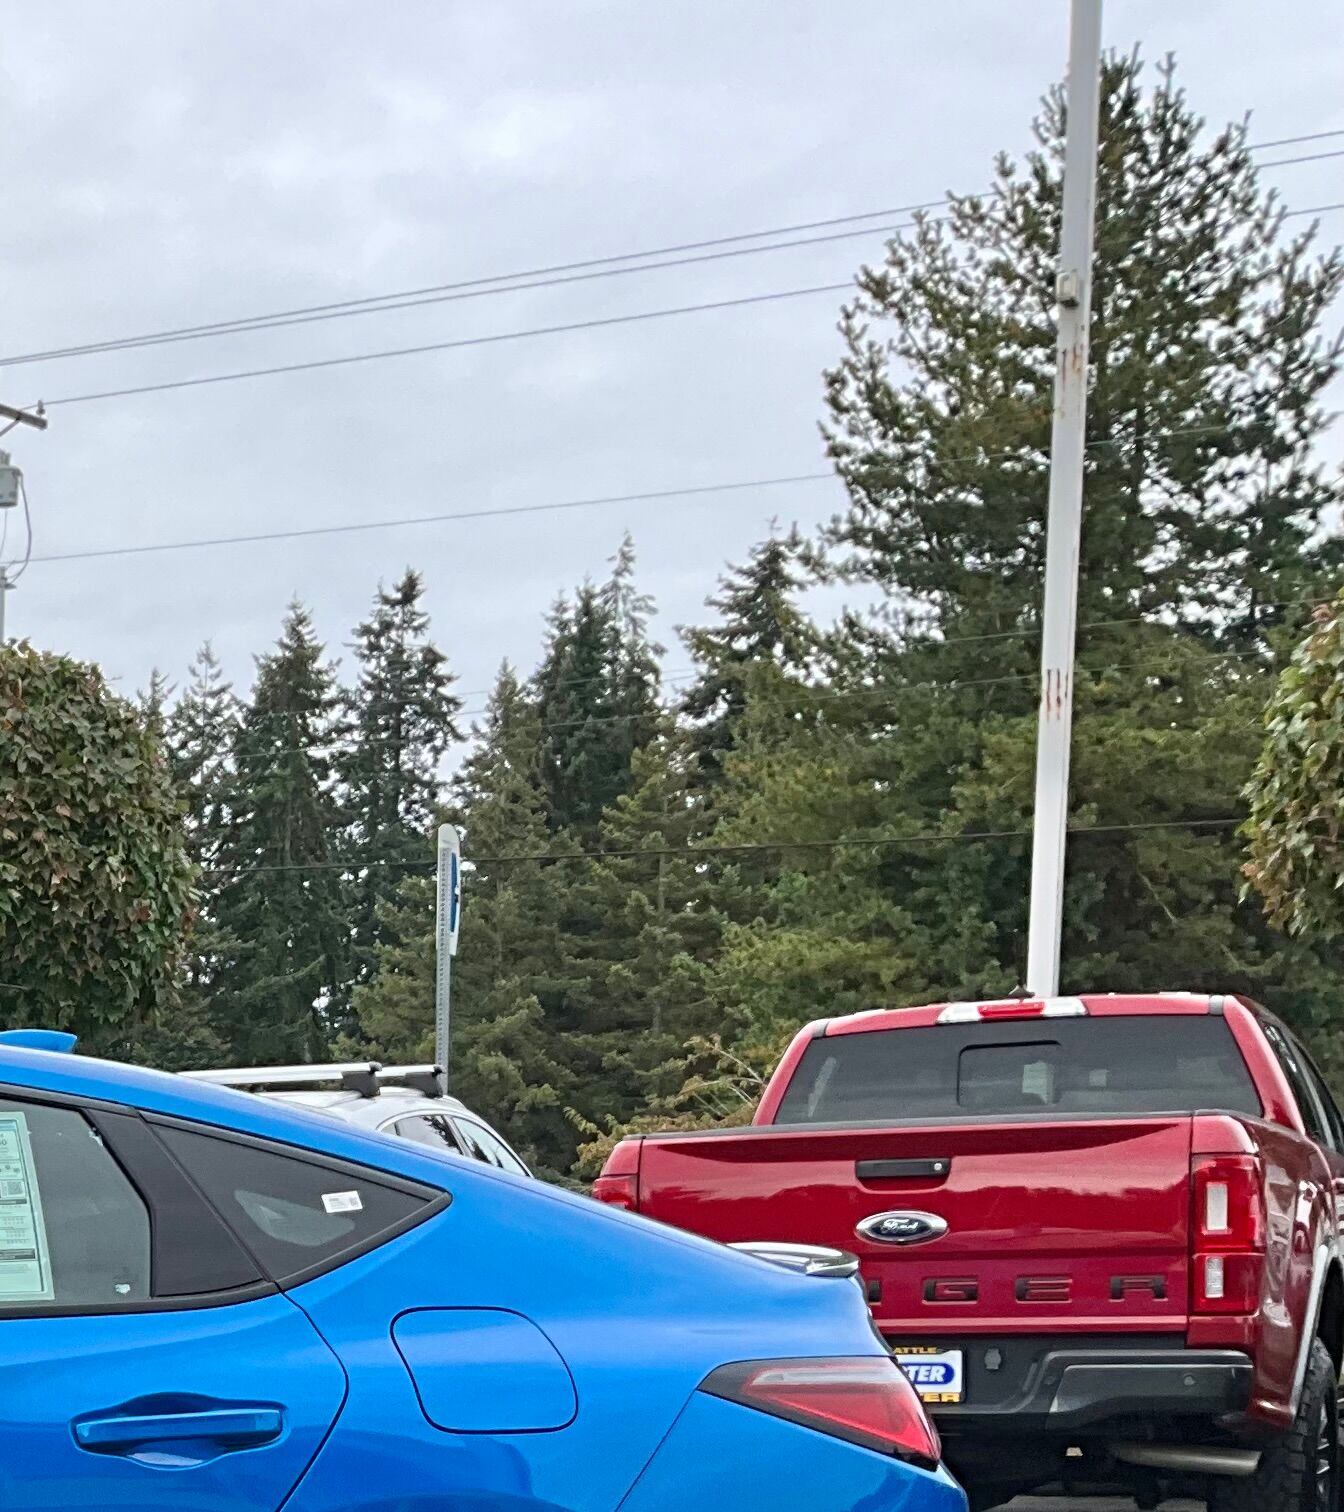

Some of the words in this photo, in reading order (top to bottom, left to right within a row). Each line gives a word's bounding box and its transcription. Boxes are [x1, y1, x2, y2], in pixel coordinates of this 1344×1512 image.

[879, 1218, 920, 1235] Ford
[891, 1346, 938, 1354] ATTLE
[903, 1365, 947, 1383] TER
